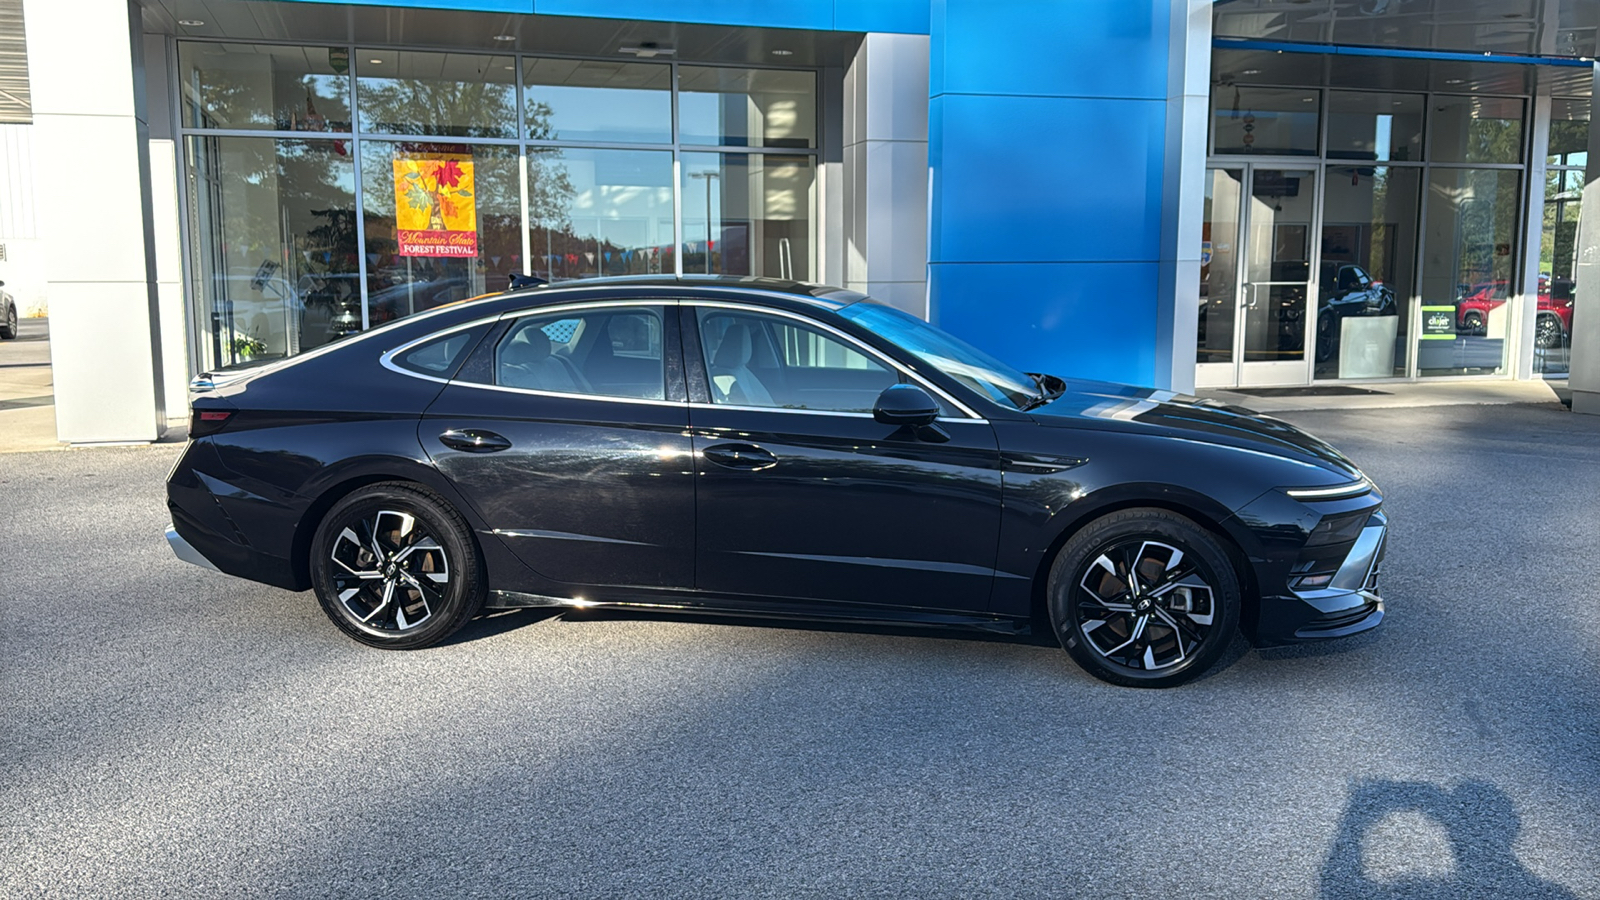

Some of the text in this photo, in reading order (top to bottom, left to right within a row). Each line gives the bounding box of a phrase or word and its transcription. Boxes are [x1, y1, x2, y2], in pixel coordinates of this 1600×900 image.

[401, 231, 475, 245] Mountain State
[404, 245, 474, 254] FOREST FESTIVAL
